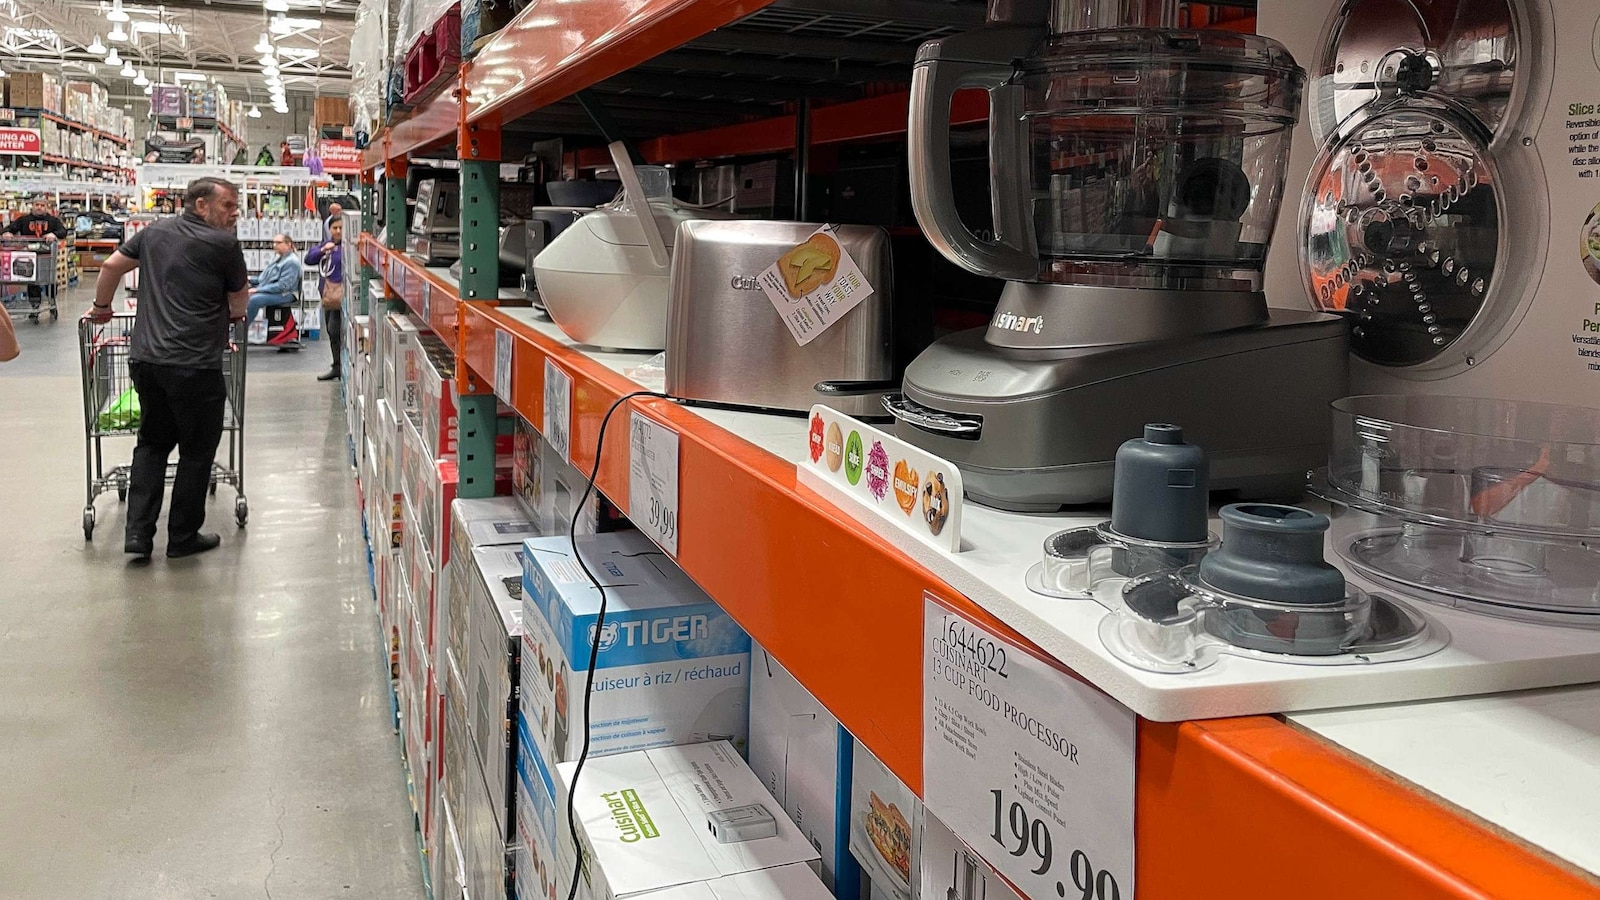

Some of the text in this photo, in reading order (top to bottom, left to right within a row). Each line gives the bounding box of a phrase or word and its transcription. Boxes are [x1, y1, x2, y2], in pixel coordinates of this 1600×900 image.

[1568, 102, 1594, 116] Slice
[20, 134, 36, 142] AID
[320, 152, 358, 162] Delivery
[832, 282, 846, 302] YOUR
[846, 270, 860, 290] YOUR
[650, 496, 675, 540] 39.99
[621, 614, 709, 647] TIGER
[941, 615, 1009, 679] 1644622
[932, 638, 988, 684] CUISINART
[643, 672, 651, 686] à
[655, 672, 672, 684] riz
[684, 662, 740, 681] réchaud
[933, 657, 1080, 766] 13 CUP FOOD PROCESSOR
[591, 734, 612, 742] onction
[600, 790, 641, 843] Cuisinart
